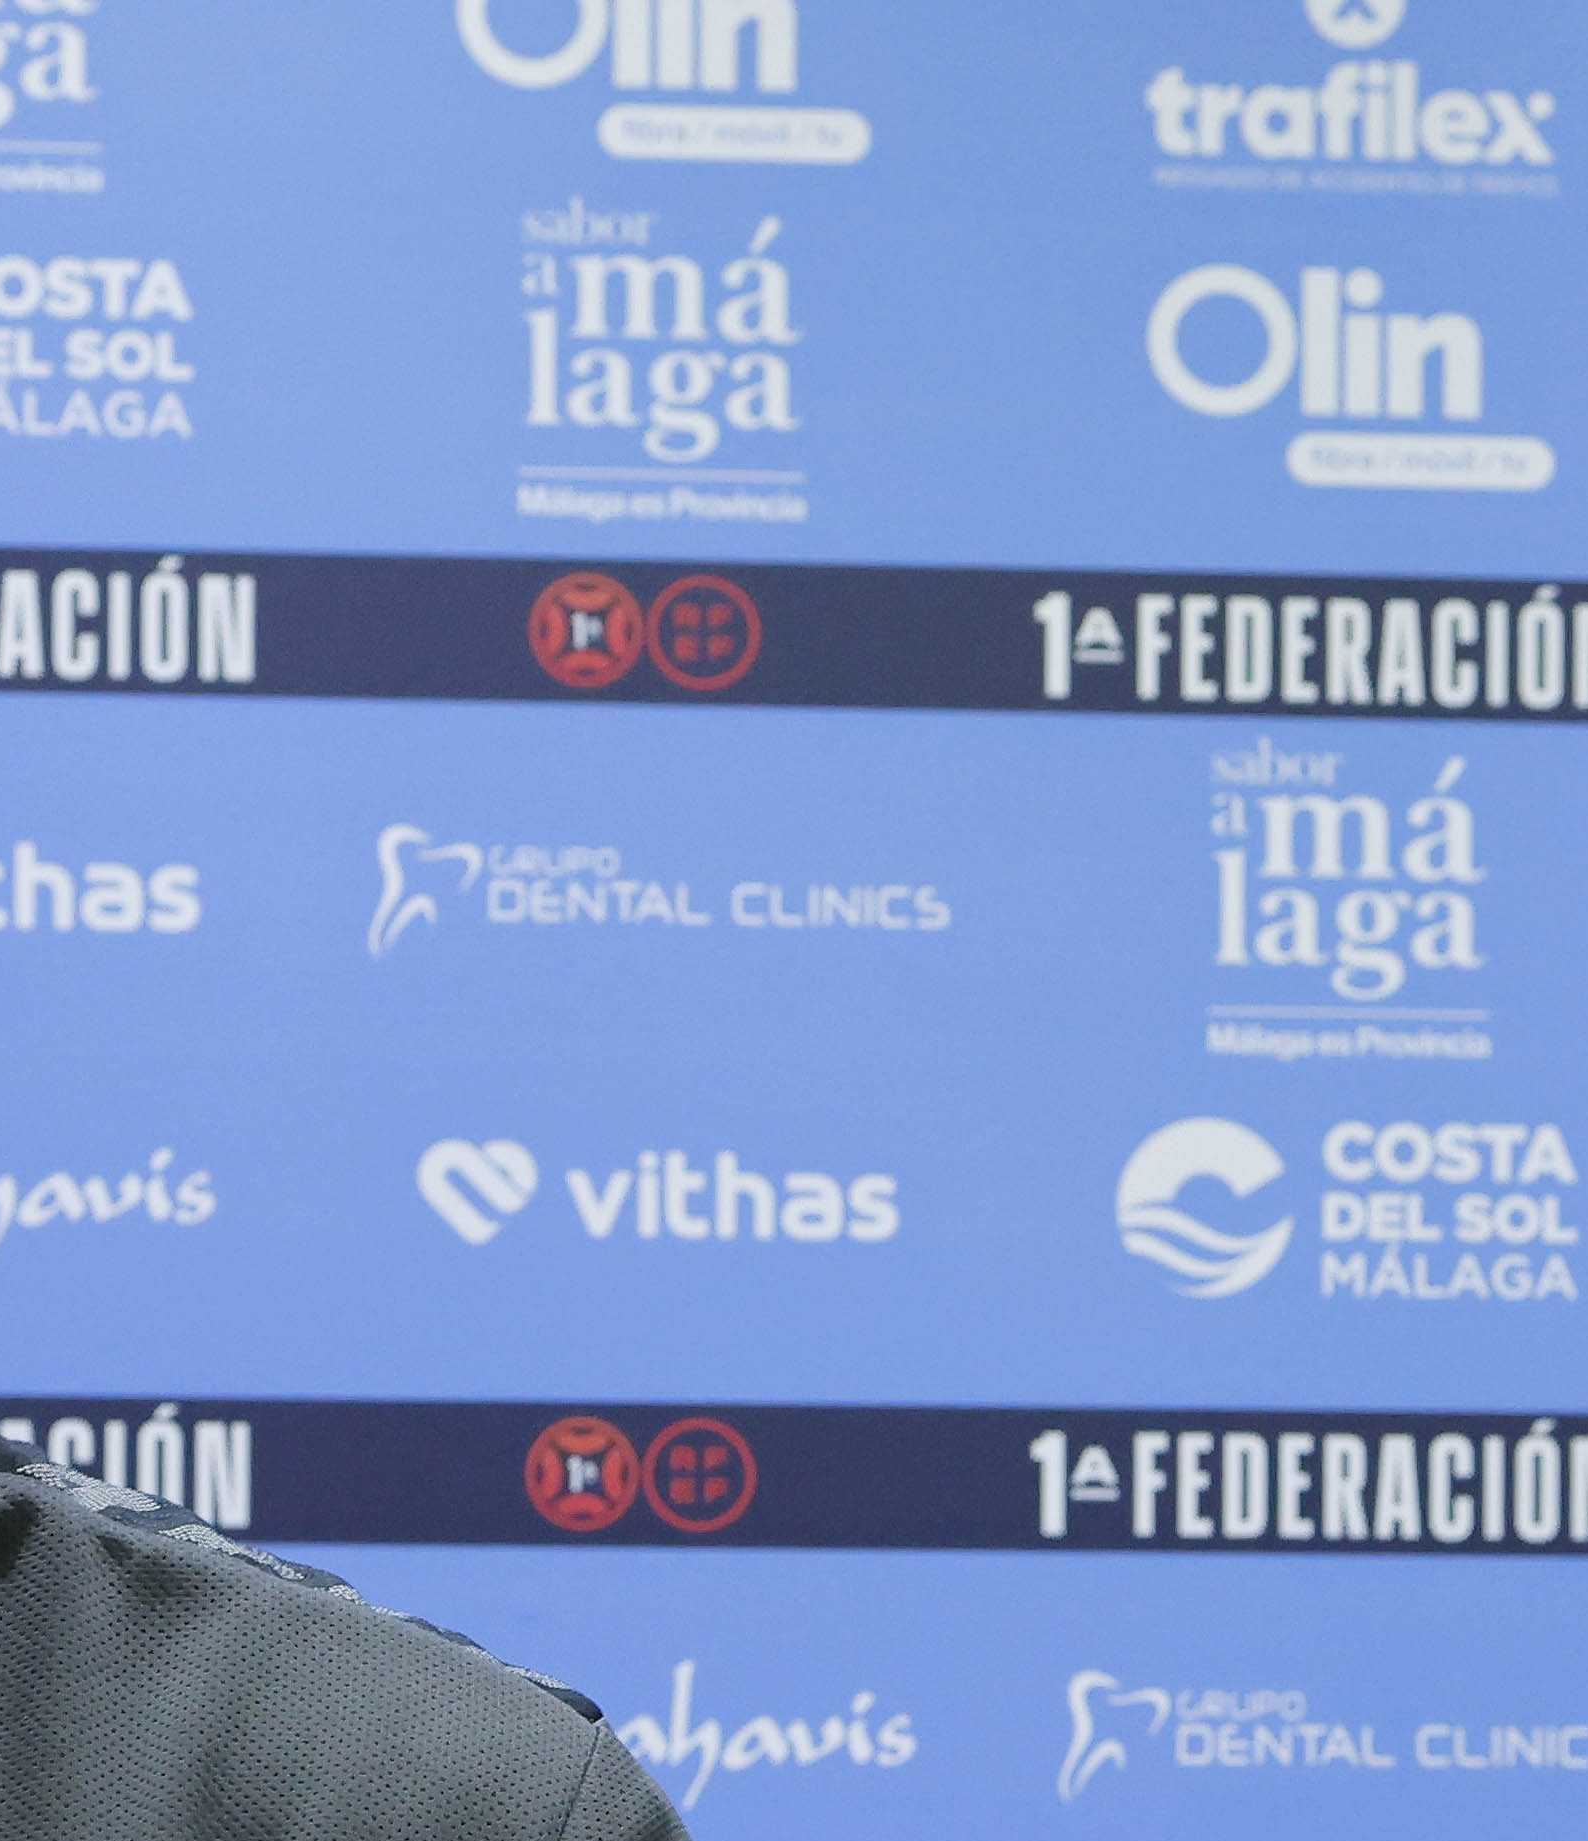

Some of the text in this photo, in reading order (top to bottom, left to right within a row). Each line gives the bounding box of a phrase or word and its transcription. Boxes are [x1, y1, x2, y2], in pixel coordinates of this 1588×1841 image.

[1146, 61, 1554, 165] trafilex
[521, 216, 797, 344] a má
[66, 329, 194, 382] SOL
[1147, 265, 1482, 420] Olin
[1211, 756, 1483, 883] a má
[487, 876, 951, 930] DENTAL CLINICS
[1323, 1121, 1577, 1184] COSTA
[566, 1151, 899, 1241] vithas
[1322, 1191, 1578, 1247] DEL SOL
[1321, 1240, 1577, 1300] MÁLAGA
[1175, 1718, 1395, 1768] DENTAL
